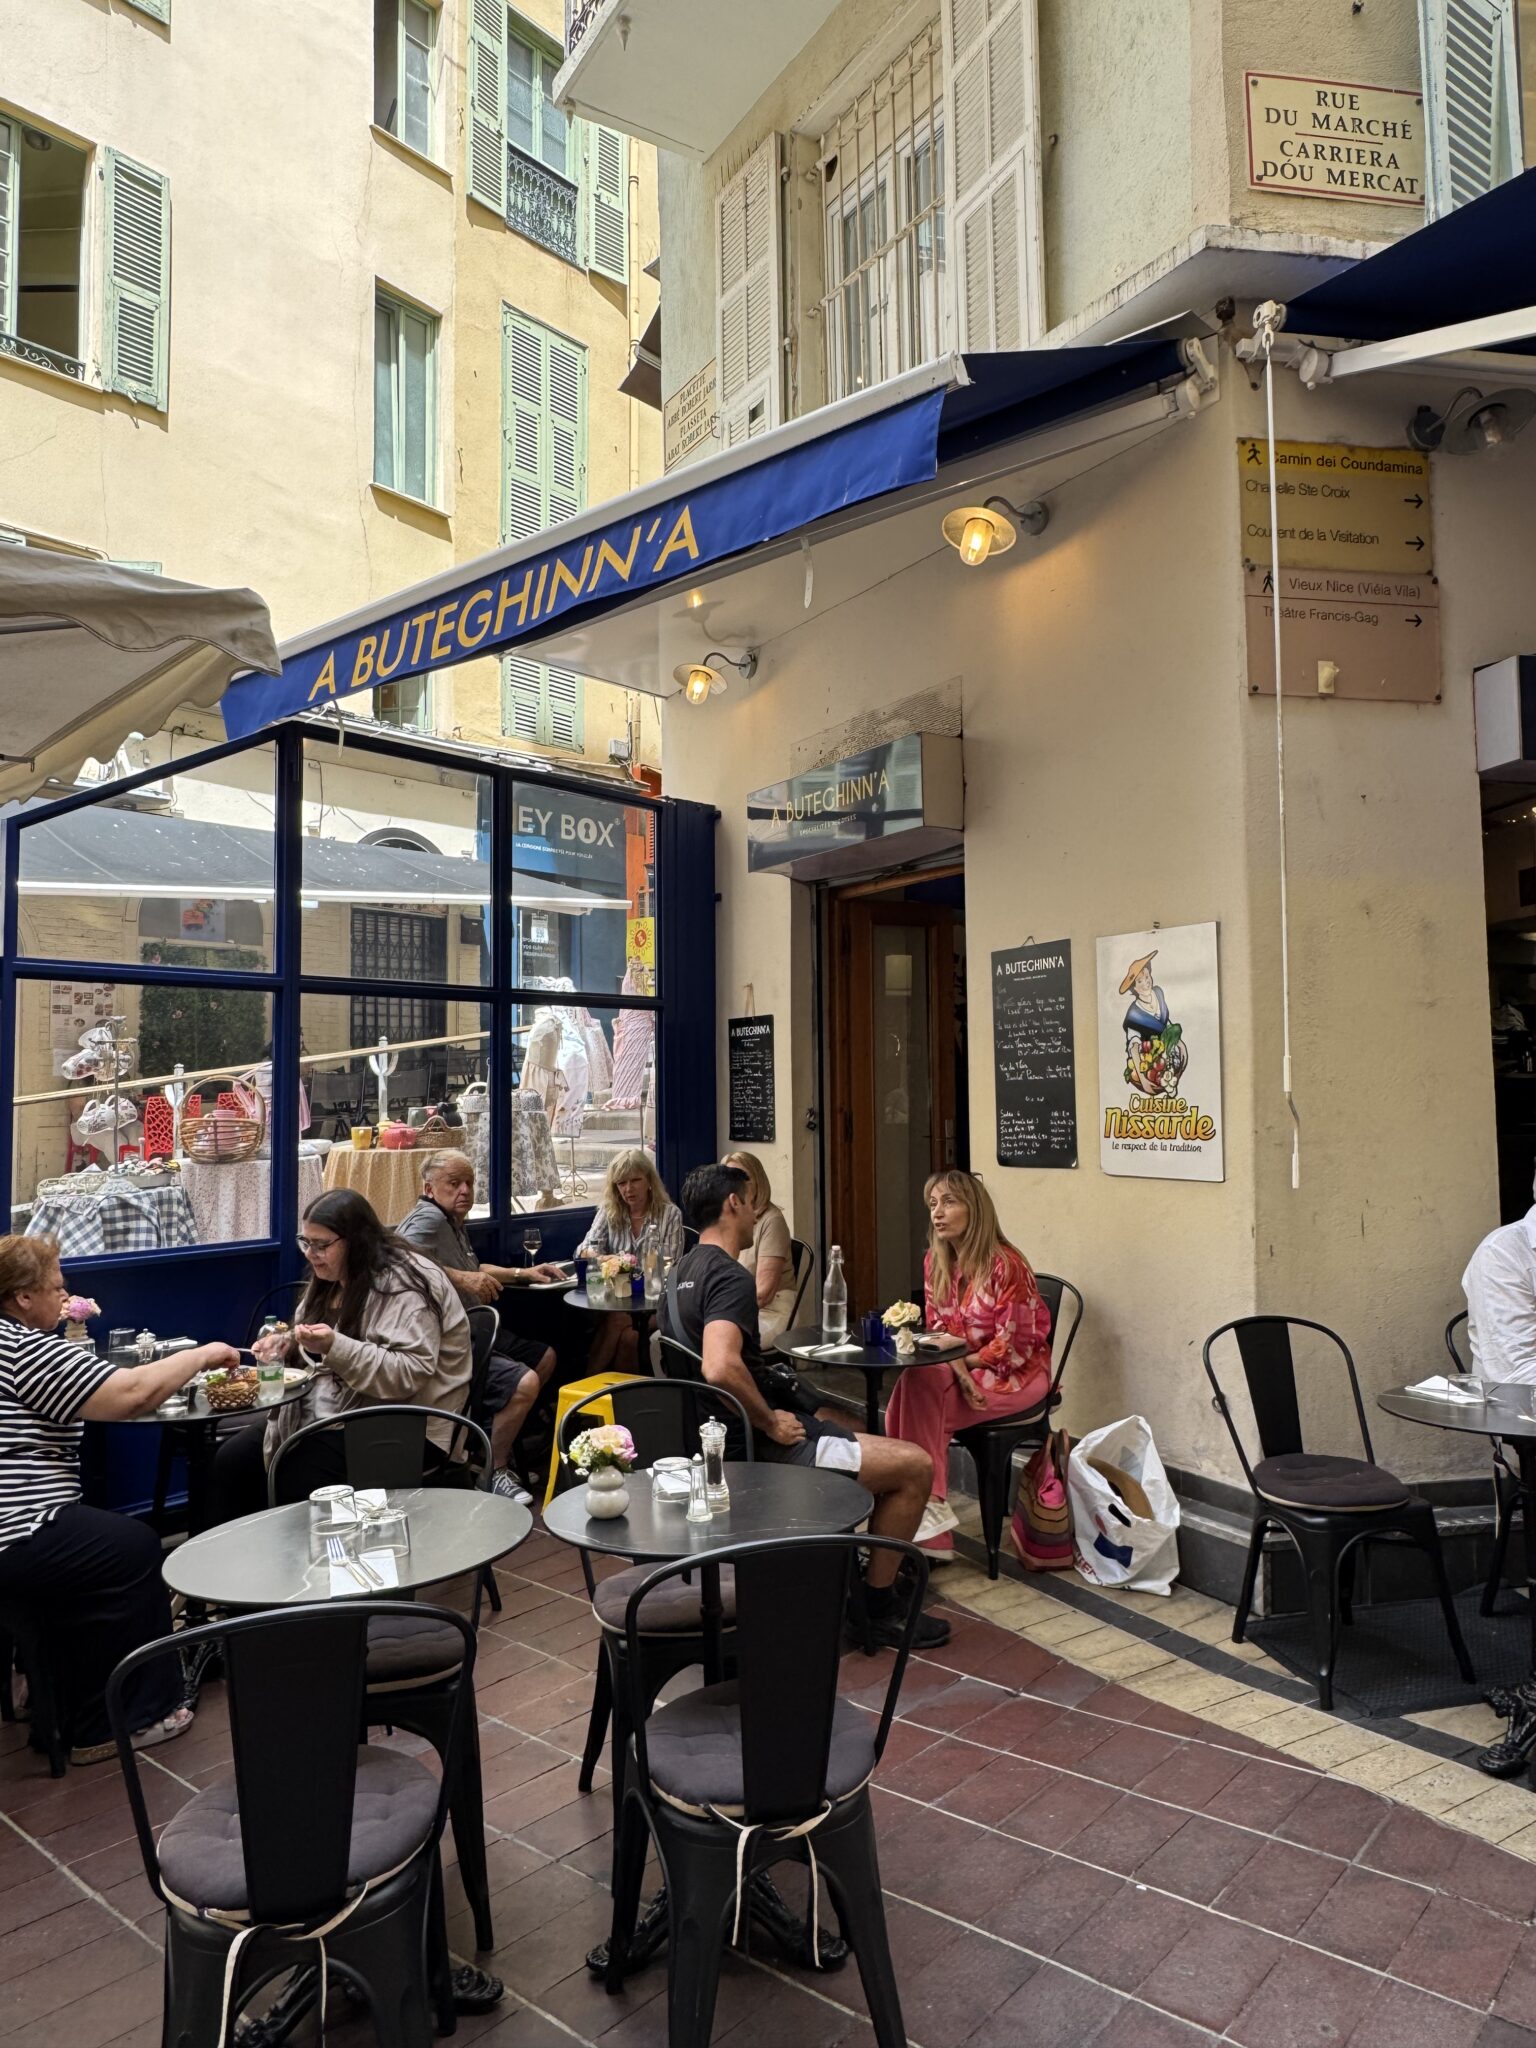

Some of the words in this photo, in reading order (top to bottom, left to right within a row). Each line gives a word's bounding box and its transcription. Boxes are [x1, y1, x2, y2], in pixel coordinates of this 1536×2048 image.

[1316, 90, 1360, 111] RUE
[1265, 107, 1298, 126] DU
[1311, 112, 1413, 140] MARCHÉ
[1279, 140, 1400, 169] CARRIERA
[1326, 168, 1418, 195] MERCAT
[681, 390, 702, 417] ROBERT
[680, 407, 707, 438] PLASSETA
[1316, 456, 1336, 468] dei
[1341, 457, 1423, 475] Coundamina
[1246, 479, 1296, 495] Chaelle
[1299, 483, 1318, 497] Ste
[1321, 485, 1350, 499] Croix
[1247, 524, 1296, 539] Couent
[1298, 528, 1314, 541] de
[1317, 528, 1326, 541] la
[1330, 530, 1379, 545] Visitation
[1289, 577, 1323, 592] Vieux
[1326, 580, 1354, 593] Nice
[307, 649, 336, 701] A
[350, 504, 700, 688] BUTEGHINN'A
[1309, 608, 1379, 627] Francis-Gag
[771, 806, 781, 828] A
[786, 768, 890, 824] BUTEGHINN'A
[996, 964, 1003, 977] A
[1005, 955, 1065, 975] BUTEGHINN'A
[1129, 1093, 1188, 1114] Cuisine
[1104, 1106, 1216, 1141] Nissarde
[1121, 1142, 1147, 1152] respect
[1149, 1142, 1158, 1151] de
[1160, 1142, 1168, 1152] la
[1169, 1142, 1202, 1152] tradition
